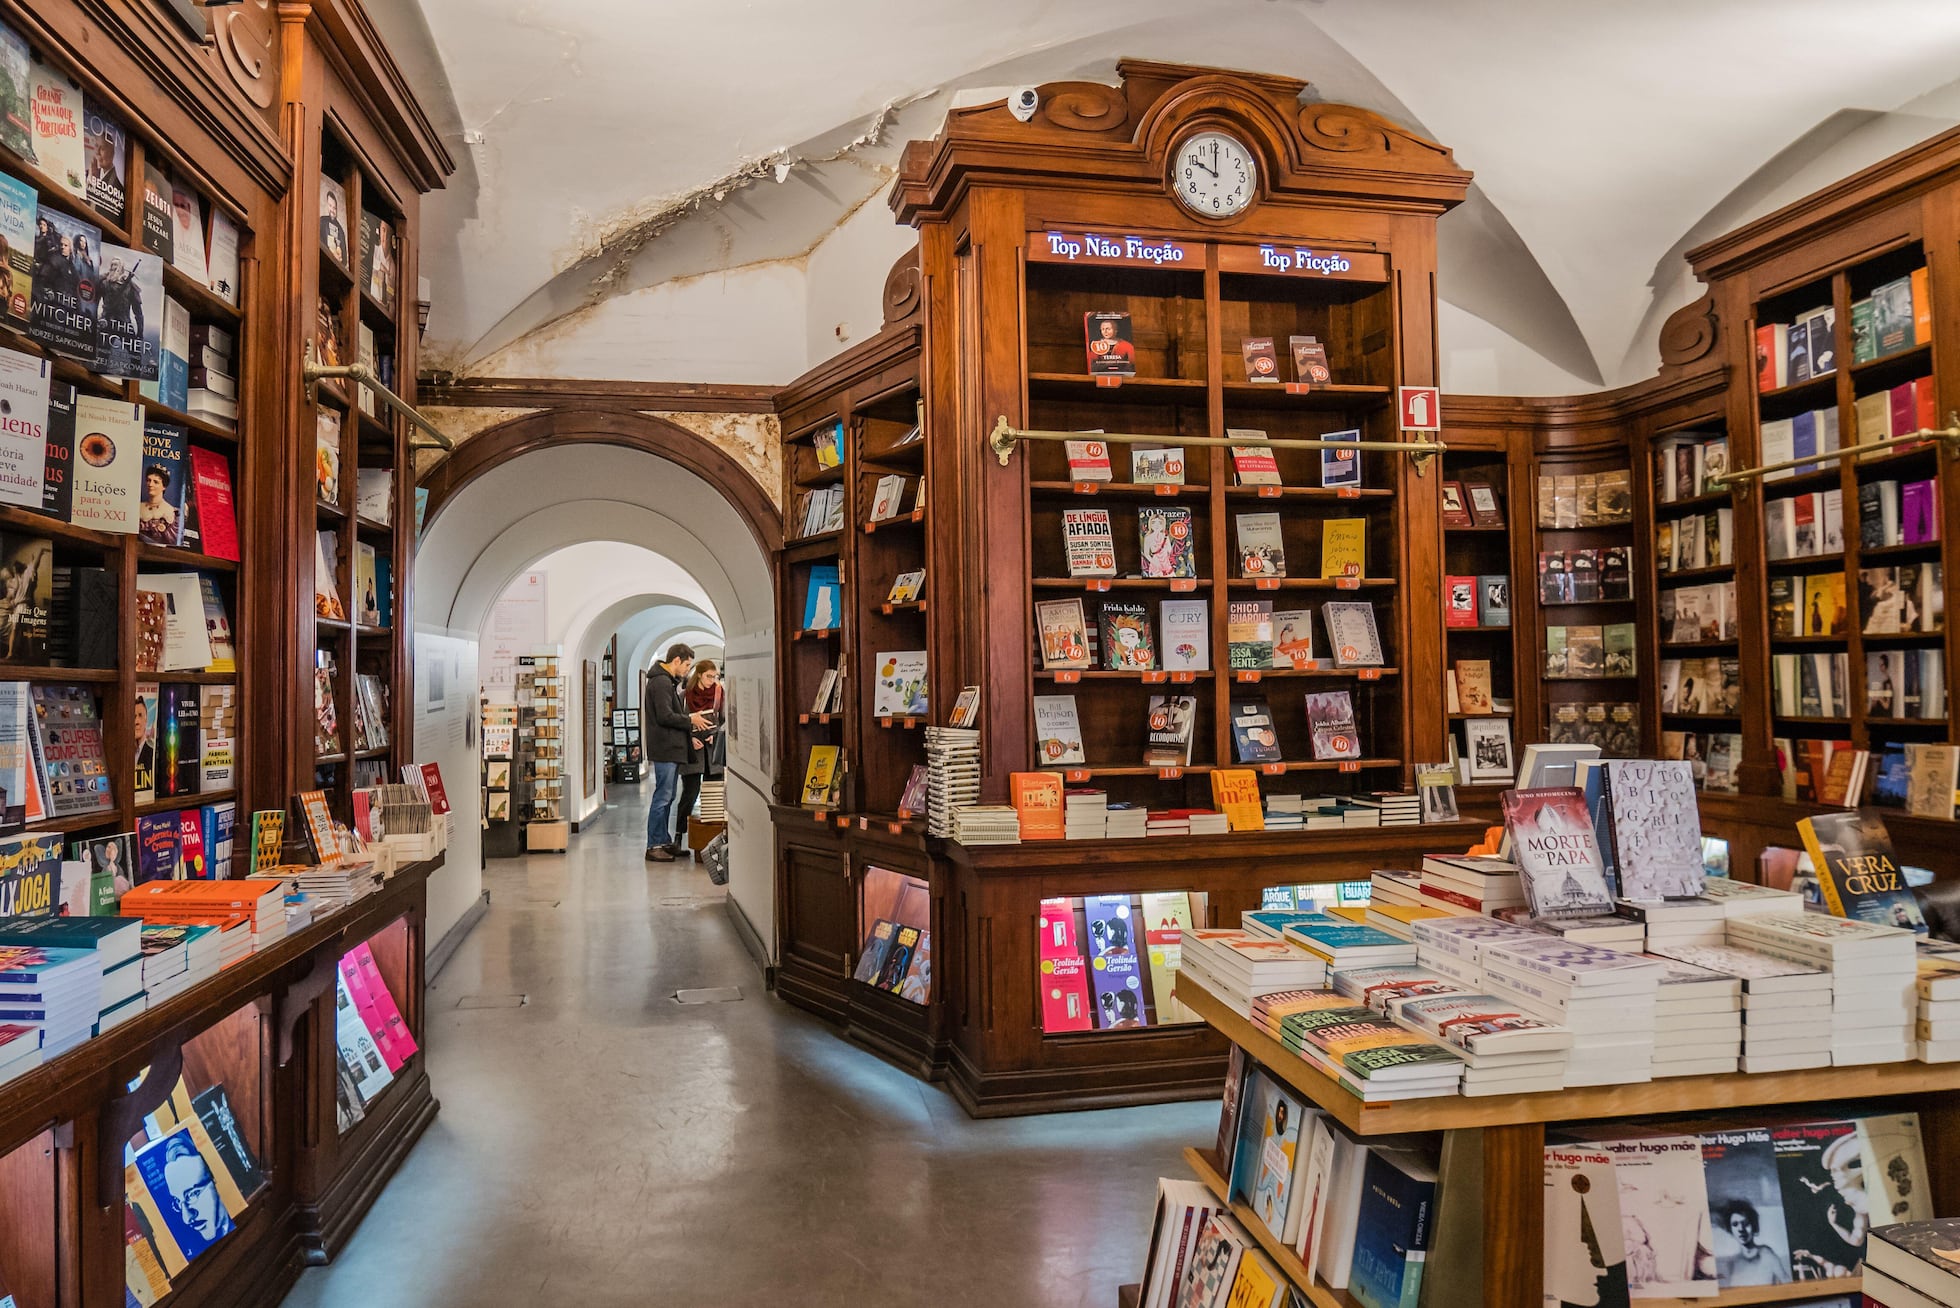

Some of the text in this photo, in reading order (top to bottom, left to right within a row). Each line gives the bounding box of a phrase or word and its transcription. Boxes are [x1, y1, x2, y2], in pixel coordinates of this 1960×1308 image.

[36, 85, 63, 106] GRANDE
[31, 98, 74, 125] ALMANAQUE
[1225, 147, 1229, 158] 1
[1234, 157, 1241, 169] 2
[1185, 168, 1192, 179] 9
[1238, 171, 1246, 183] 3
[87, 174, 126, 202] ABEDORIA
[1189, 182, 1197, 193] 8
[1234, 185, 1242, 196] 4
[145, 189, 172, 217] ZELOTA
[1199, 192, 1206, 204] 7
[1213, 197, 1220, 209] 6
[1226, 194, 1233, 206] 5
[0, 198, 21, 217] NHEI
[4, 211, 25, 231] VIDA
[1047, 235, 1183, 265] Top Não Ficção
[1259, 247, 1350, 275] Top Ficção
[56, 291, 78, 310] THE
[31, 300, 93, 334] WITCHER
[110, 319, 134, 335] THE
[29, 327, 55, 342] NDRZEJ
[55, 334, 94, 353] SAPKOWSKI
[100, 332, 153, 356] TCHER
[1257, 360, 1273, 371] 30
[1313, 368, 1328, 379] 30
[0, 382, 38, 397] oah Harari
[2, 416, 42, 439] iens
[143, 435, 172, 450] NOVE
[46, 442, 69, 462] mo
[143, 446, 181, 461] NÍFICAS
[45, 466, 64, 484] us
[84, 480, 127, 497] Lições
[1083, 484, 1090, 493] 2
[1163, 485, 1171, 495] 3
[1267, 487, 1274, 496] 2
[80, 495, 111, 506] para o
[103, 508, 127, 521] XXI
[1067, 511, 1108, 523] DE LÍNGUA
[1146, 508, 1153, 518] O
[1068, 522, 1110, 536] AFIADA
[33, 606, 48, 618] Que
[1103, 602, 1146, 613] Frida Kahlo
[1230, 603, 1259, 614] CHICO
[20, 614, 47, 627] Imagens
[1231, 647, 1252, 658] ESSA
[1231, 657, 1257, 668] GENTE
[1064, 672, 1071, 682] 6
[1151, 672, 1157, 681] 7
[1179, 672, 1187, 681] 8
[1245, 671, 1252, 682] 6
[1366, 670, 1373, 679] 8
[61, 729, 100, 744] CURSO
[44, 744, 103, 761] COMPLETO
[1270, 764, 1278, 773] 9
[1344, 762, 1357, 771] 10
[134, 769, 152, 790] LIN
[426, 774, 438, 786] 200
[1074, 771, 1082, 780] 9
[1164, 768, 1178, 779] 10
[1549, 826, 1556, 834] A
[182, 833, 201, 846] TIVA
[1528, 834, 1593, 851] MORTE
[1547, 850, 1591, 867] PAPA
[1836, 855, 1895, 876] VERA
[1845, 872, 1903, 896] CRUZ
[15, 872, 51, 915] JOGA
[1263, 891, 1291, 903] ARQUE
[1344, 886, 1372, 900] BUAR
[1052, 957, 1085, 967] Teolinda
[1106, 954, 1138, 965] Teolinda
[1053, 966, 1079, 976] Gersão
[1106, 964, 1132, 974] Gersão
[1261, 989, 1316, 1003] CHICO
[1292, 1011, 1337, 1023] ESSA
[1300, 1015, 1357, 1029] GENTE
[1316, 1022, 1377, 1036] CHICO
[1356, 1049, 1405, 1063] ESSA
[1366, 1053, 1428, 1069] GENTE
[1698, 1131, 1770, 1146] lter Hugo Mãe
[1802, 1128, 1831, 1140] hugo
[1605, 1141, 1696, 1155] valter hugo mãe
[1553, 1151, 1583, 1165] hugo
[1585, 1153, 1610, 1164] mãe
